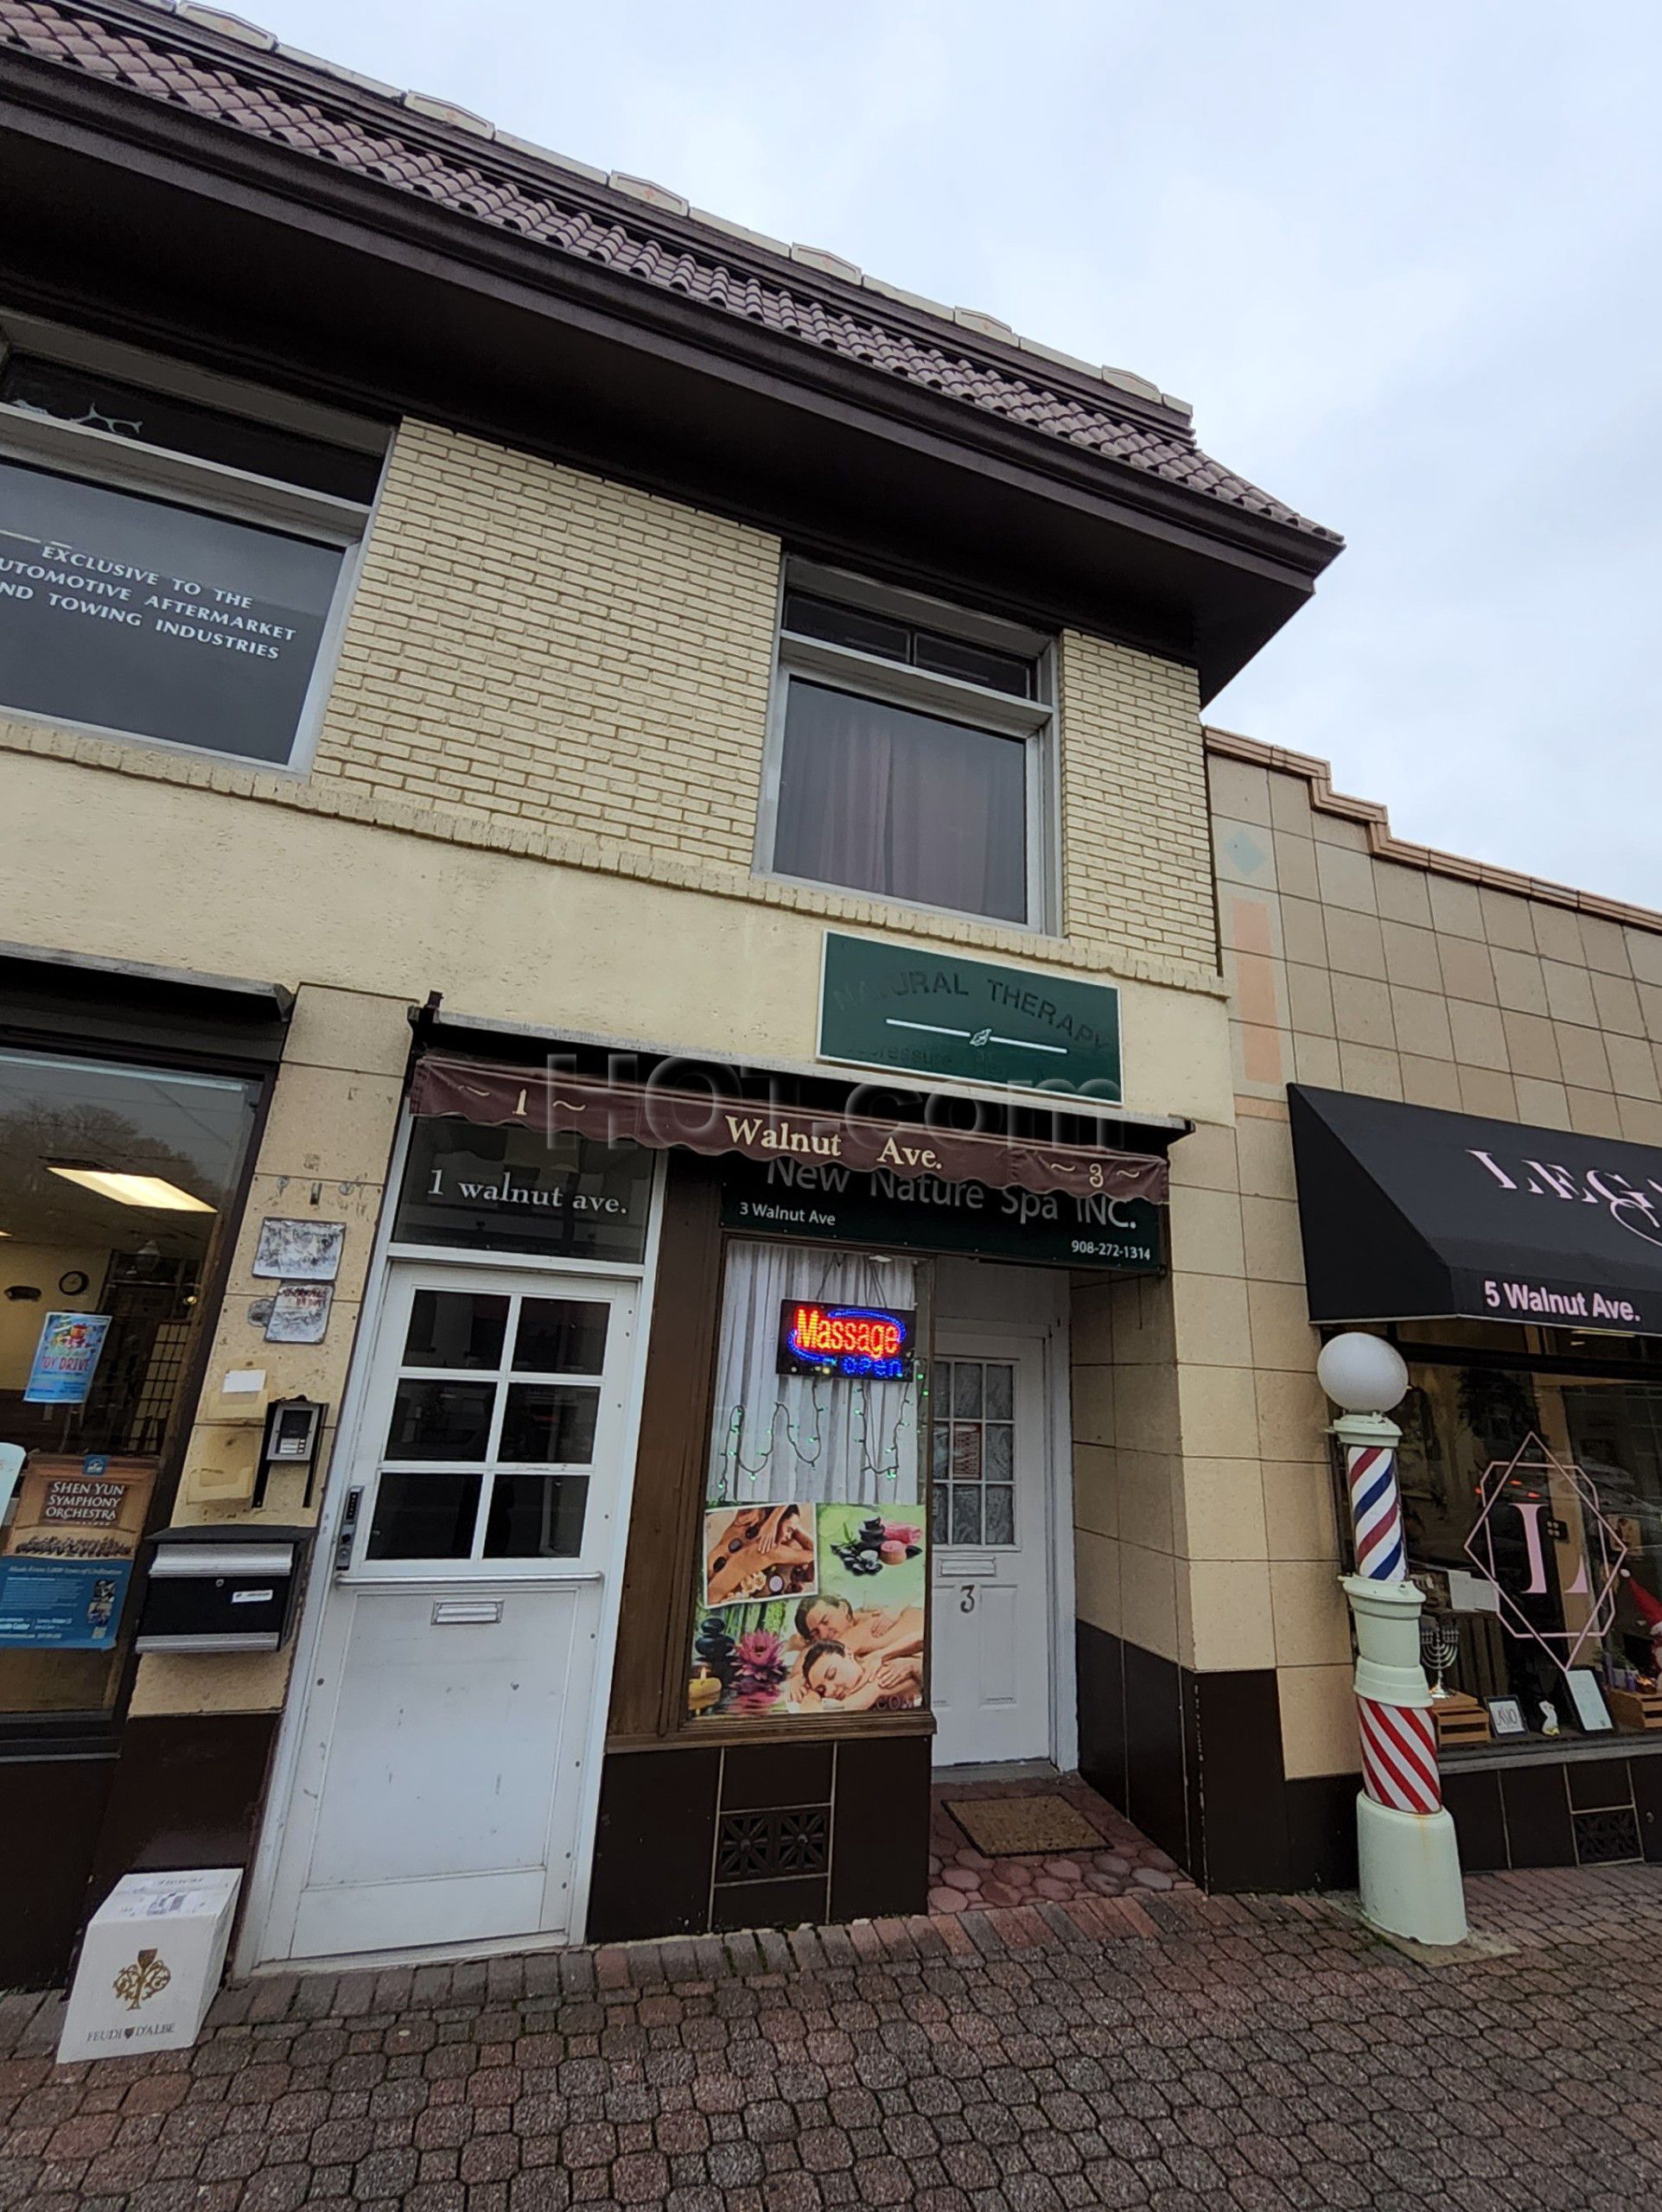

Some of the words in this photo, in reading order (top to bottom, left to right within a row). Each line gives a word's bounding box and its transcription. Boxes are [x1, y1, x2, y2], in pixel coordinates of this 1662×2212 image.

[41, 545, 160, 586] EXCLUSIVE
[172, 578, 201, 596] TO
[213, 588, 253, 610] THE
[48, 593, 143, 626] TOWING
[156, 618, 281, 660] INDUSTRIES
[144, 594, 297, 642] AFTERMARKET
[834, 969, 971, 1013] NURAL
[512, 1089, 528, 1116] 1
[724, 1115, 842, 1158] Walnut
[876, 1136, 943, 1170] Ave.
[1089, 1163, 1105, 1188] 3
[427, 1169, 443, 1196] 1
[458, 1172, 564, 1208] walnut
[572, 1192, 627, 1215] ave.
[767, 1159, 851, 1192] New
[869, 1169, 984, 1210] Nature
[1001, 1189, 1059, 1224] Spa
[1465, 1148, 1662, 1210] LEG
[740, 1202, 748, 1215] 3
[752, 1203, 806, 1223] Walnut
[809, 1210, 836, 1226] Ave
[1071, 1238, 1150, 1261] 908-272-1314
[1484, 1280, 1500, 1307] 5
[1503, 1282, 1589, 1317] Walnut
[1592, 1293, 1641, 1321] Ave.
[795, 1306, 901, 1359] Massage
[48, 1494, 121, 1508] SYMPHONY
[52, 1481, 91, 1494] SHEN
[94, 1483, 125, 1496] YUN
[45, 1506, 117, 1521] ORCHESTRA
[960, 1584, 975, 1613] 3
